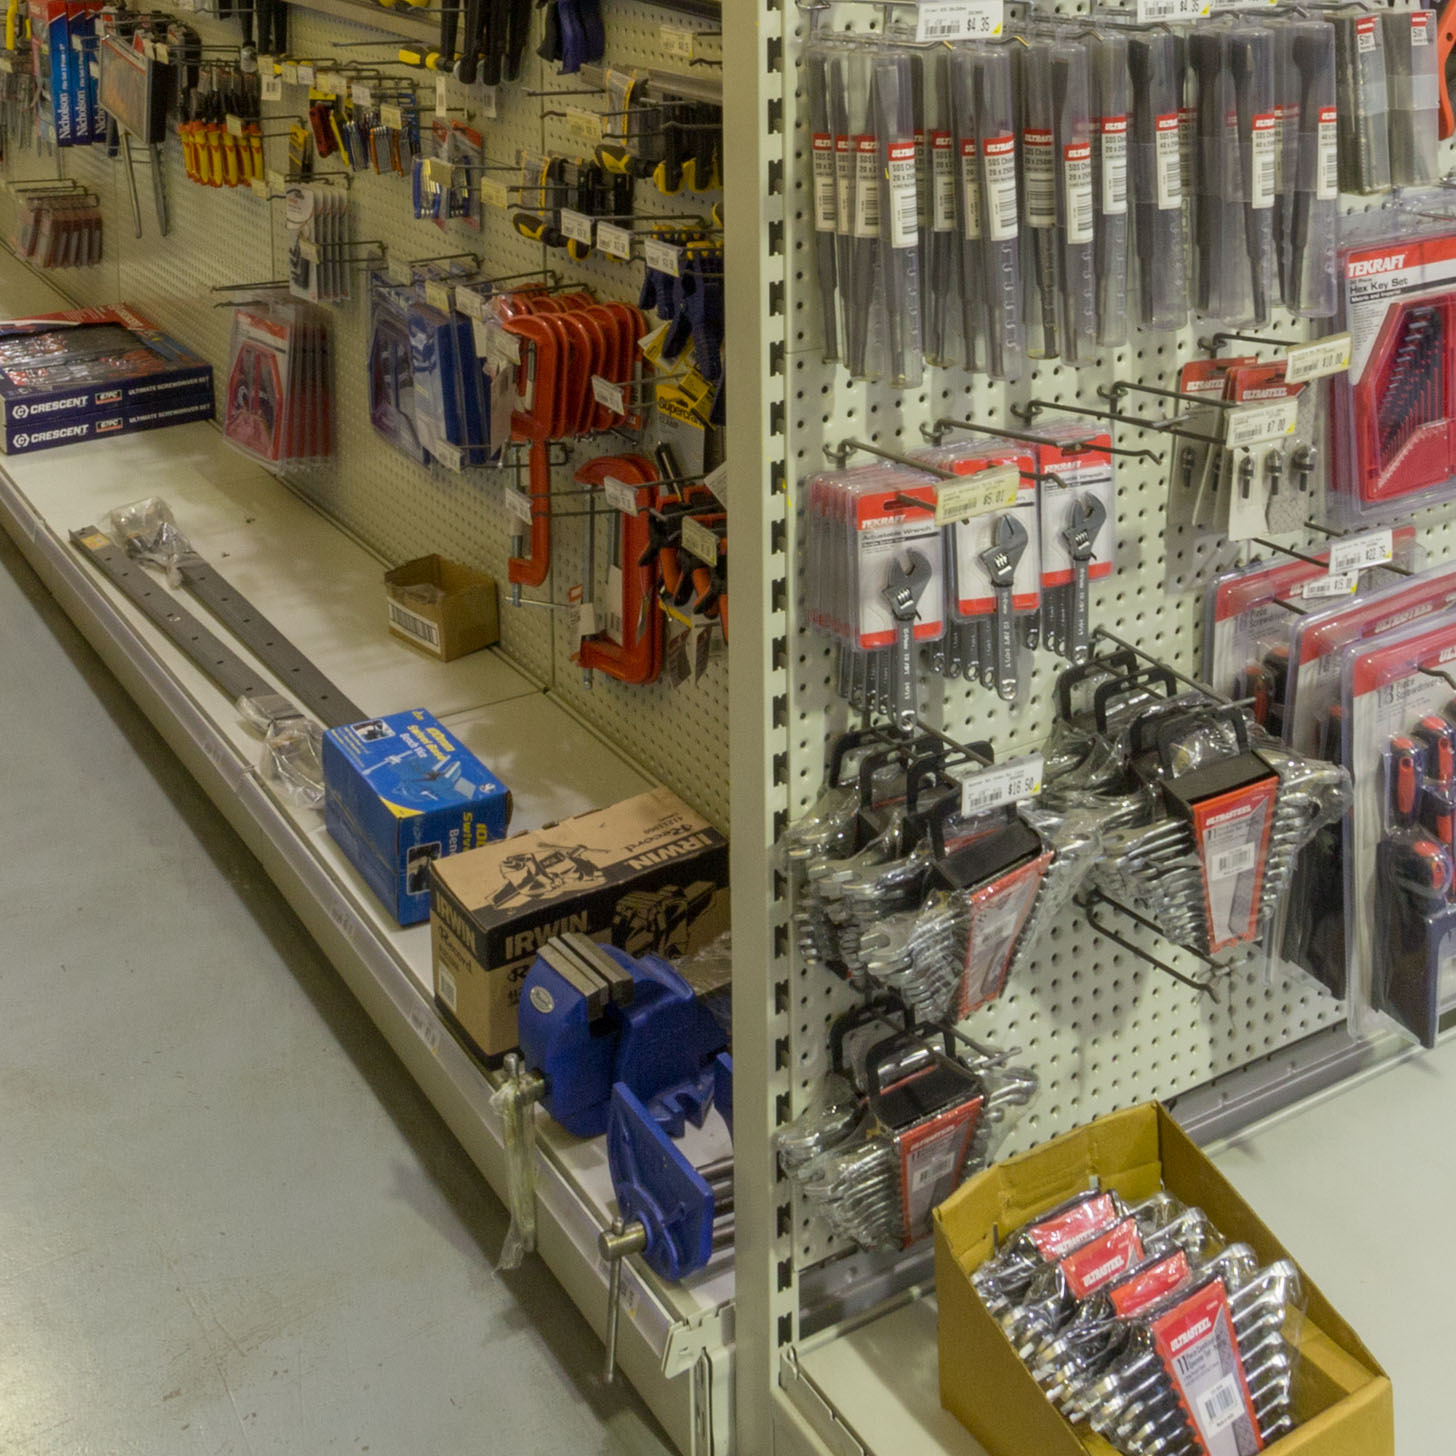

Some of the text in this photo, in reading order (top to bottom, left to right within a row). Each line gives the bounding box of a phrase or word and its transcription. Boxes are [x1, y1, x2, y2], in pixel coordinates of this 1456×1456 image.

[967, 17, 990, 32] $4.35
[59, 92, 72, 140] Nicholson
[1349, 254, 1406, 277] TEKRAFT
[1350, 277, 1408, 294] Hex Key Set
[30, 396, 88, 414] CRESCENT
[30, 424, 89, 443] CRESCENT
[862, 514, 906, 530] TEKRAFT
[625, 832, 714, 871] IRWIN
[436, 891, 476, 954] IRWIN
[506, 910, 588, 960] IRWIN
[1170, 1318, 1212, 1352] ULTRASTEEL
